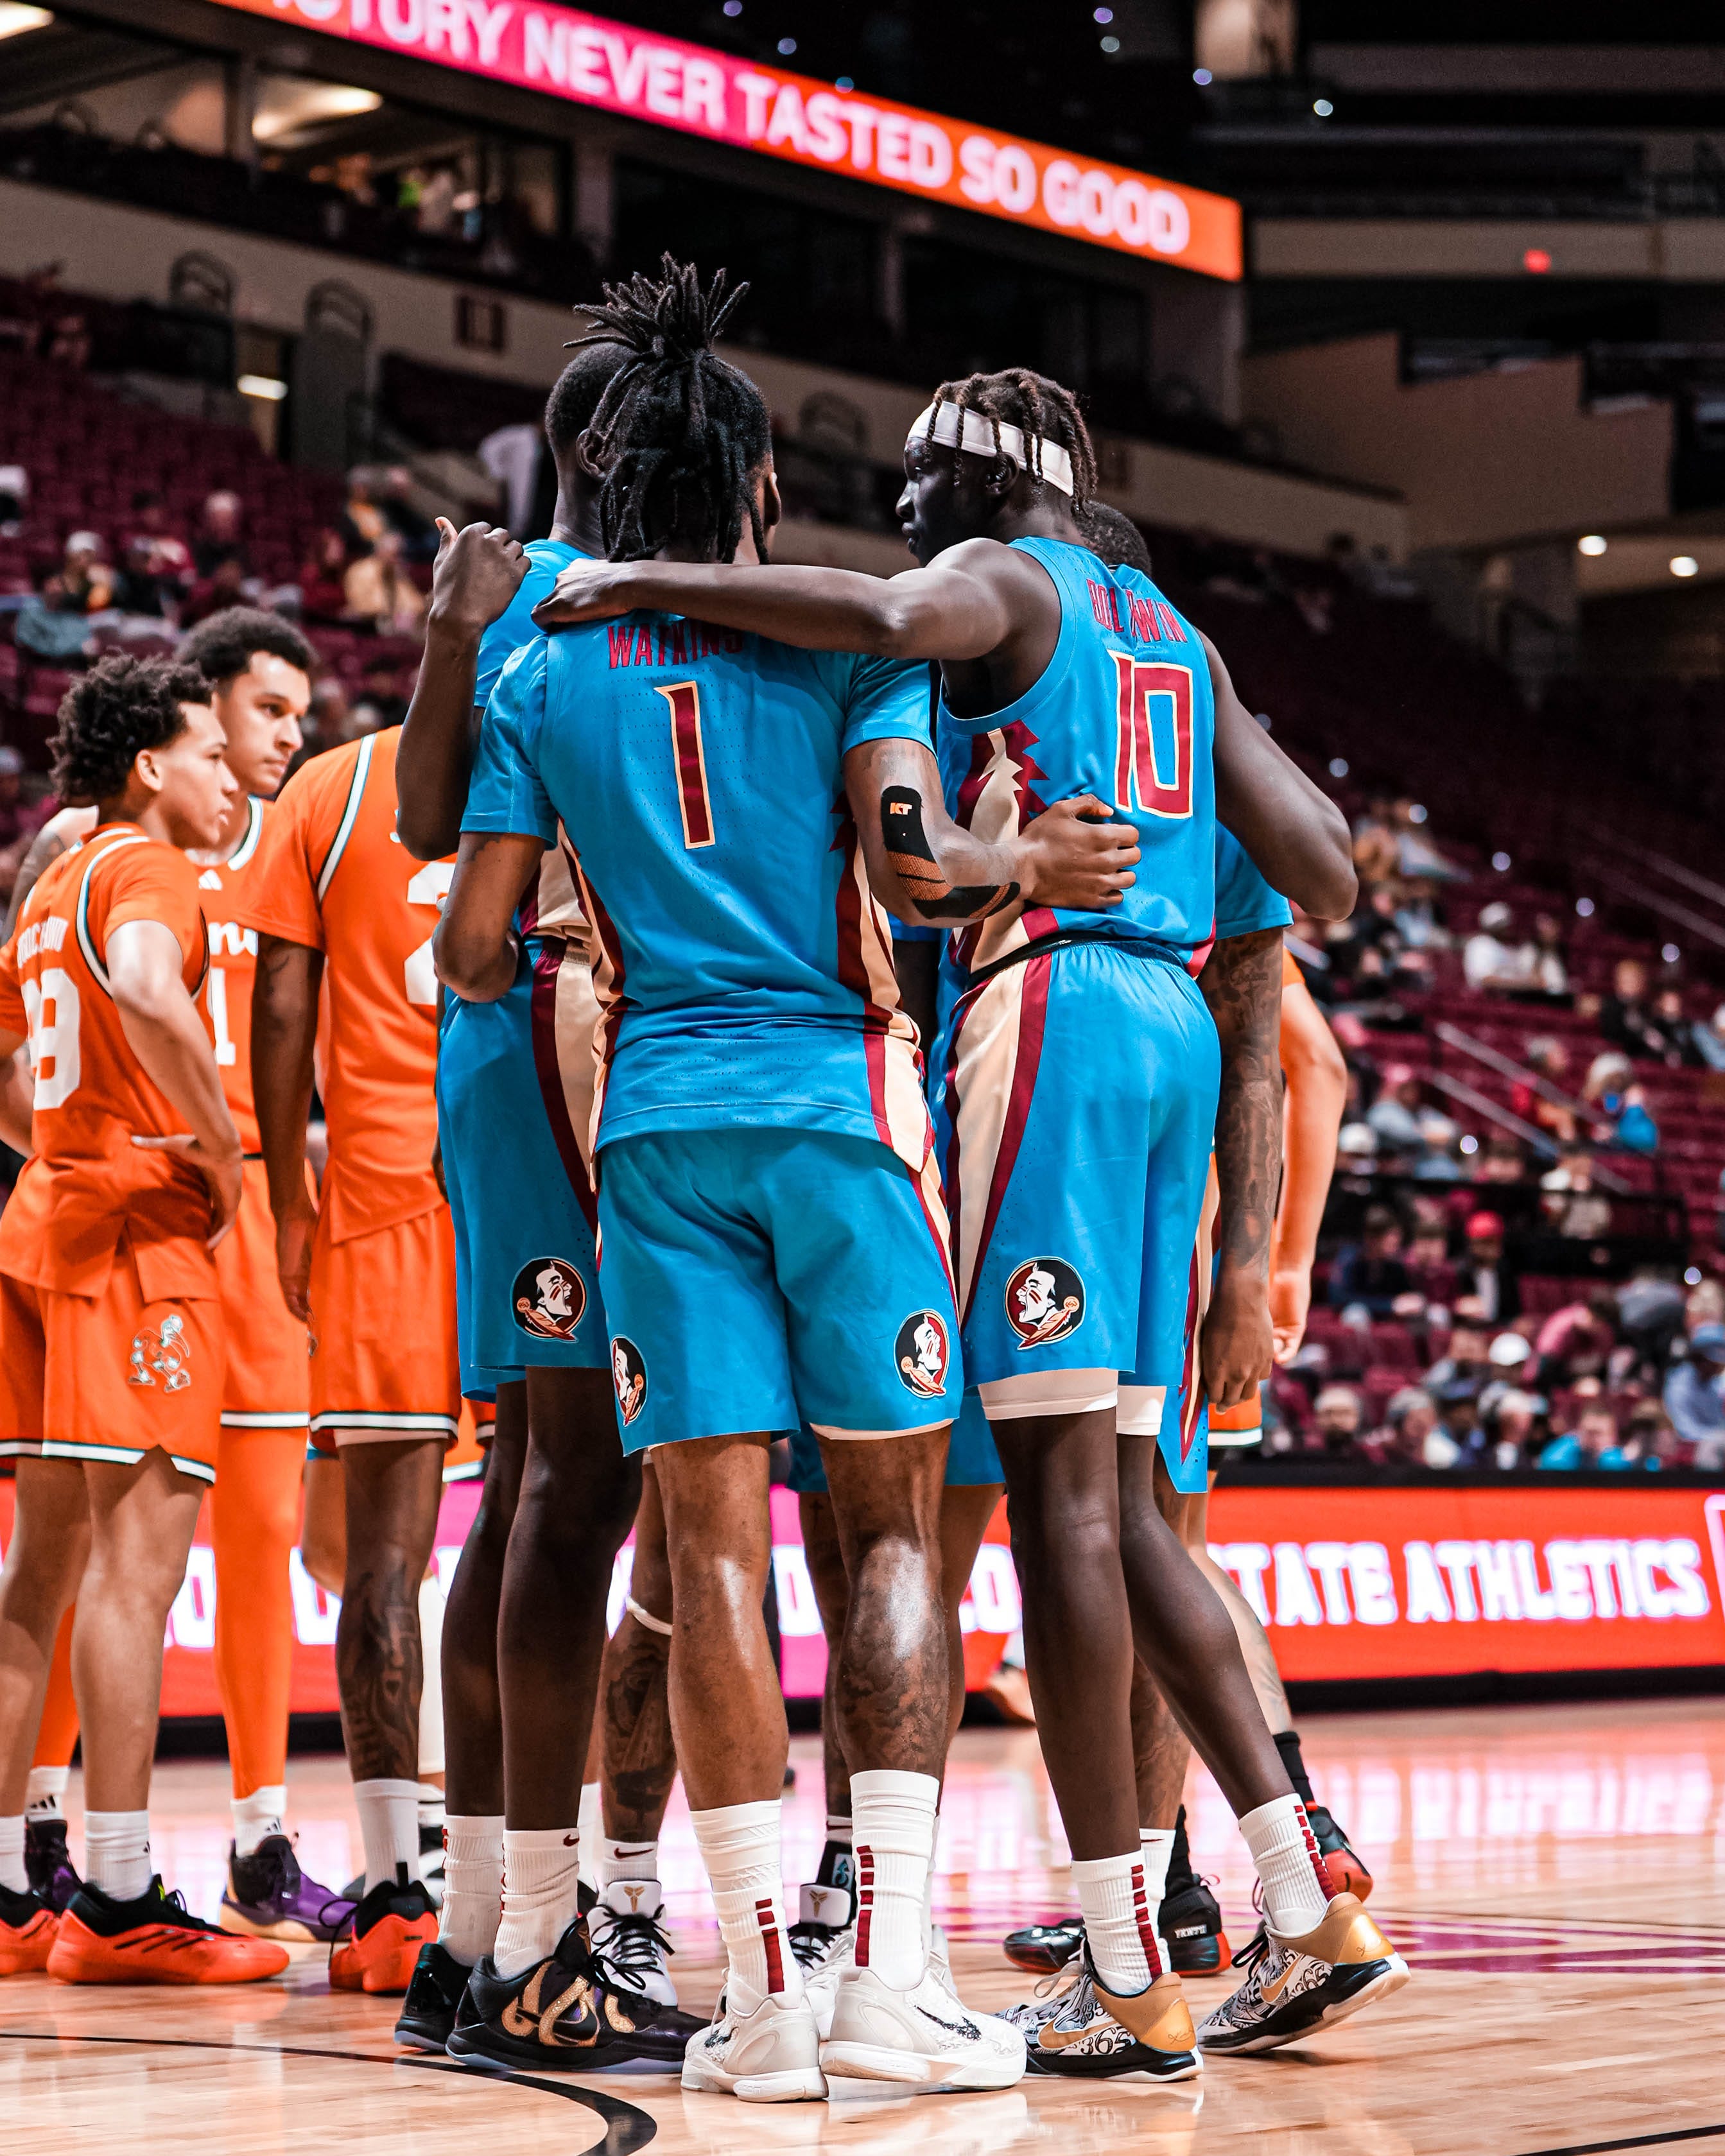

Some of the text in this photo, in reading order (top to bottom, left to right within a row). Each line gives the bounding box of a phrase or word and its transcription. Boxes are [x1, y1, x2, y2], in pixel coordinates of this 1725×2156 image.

[523, 13, 726, 128] NEVER
[735, 72, 952, 189] TASTED
[959, 135, 1036, 213] SO
[1042, 160, 1190, 255] GOOD
[654, 680, 715, 850] 1
[890, 802, 913, 815] KT
[1107, 649, 1193, 819] 10
[1208, 1537, 1710, 1626] TATE ATHLETICS
